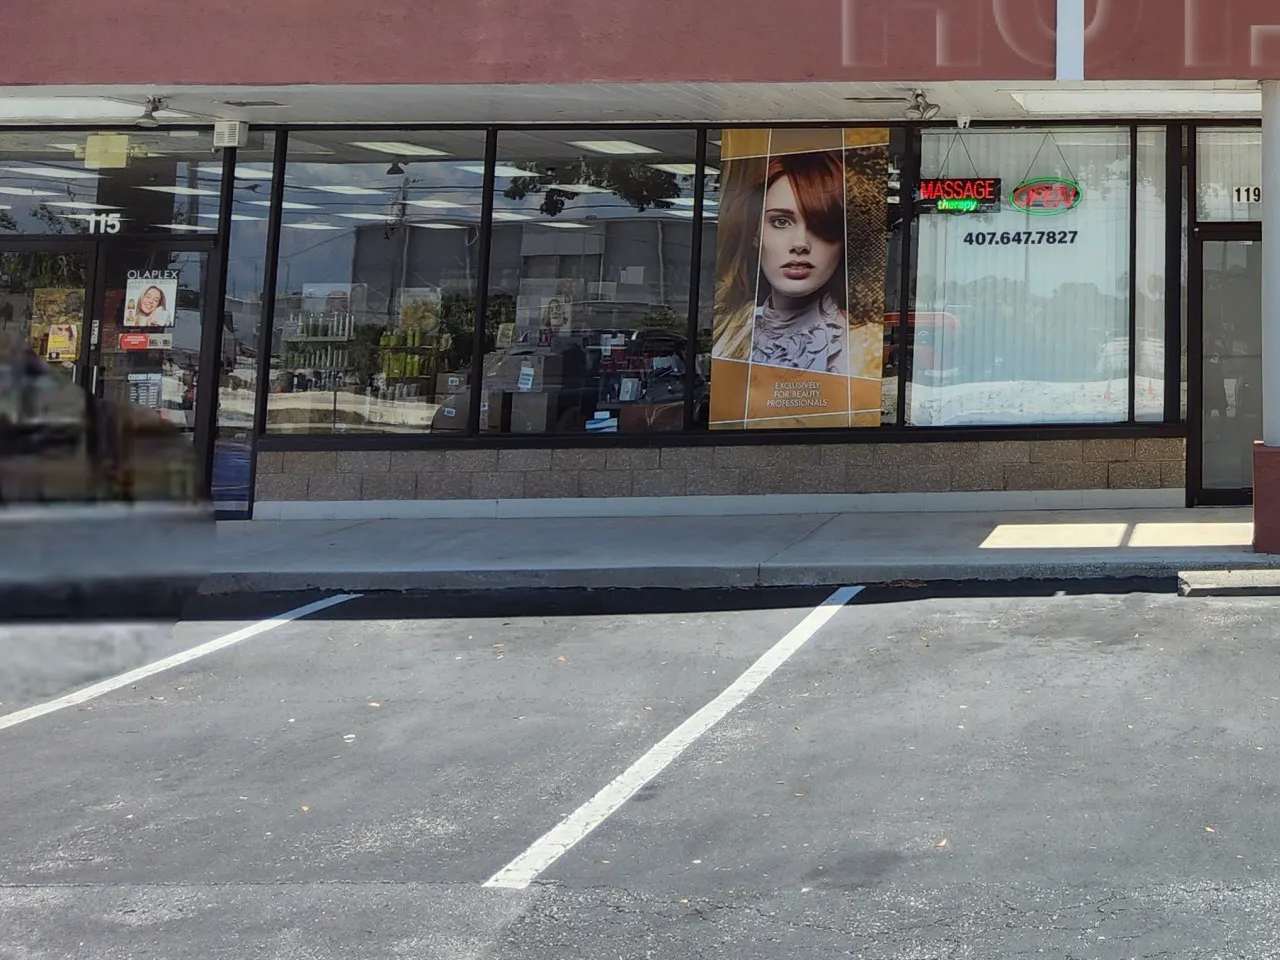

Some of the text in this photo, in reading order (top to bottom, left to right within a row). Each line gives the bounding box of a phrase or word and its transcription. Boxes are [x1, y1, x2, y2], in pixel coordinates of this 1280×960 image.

[920, 180, 995, 200] MASSAGE
[1013, 185, 1077, 208] OPEN
[1235, 187, 1261, 202] 119
[937, 199, 978, 211] therapy
[86, 213, 121, 234] 115
[963, 231, 1078, 245] 407.647.7827
[127, 269, 179, 279] OLAPLEX
[775, 381, 820, 390] EXCLUSIVELY
[792, 390, 820, 398] BEAUTY
[767, 399, 828, 408] PROFESSIONALS
